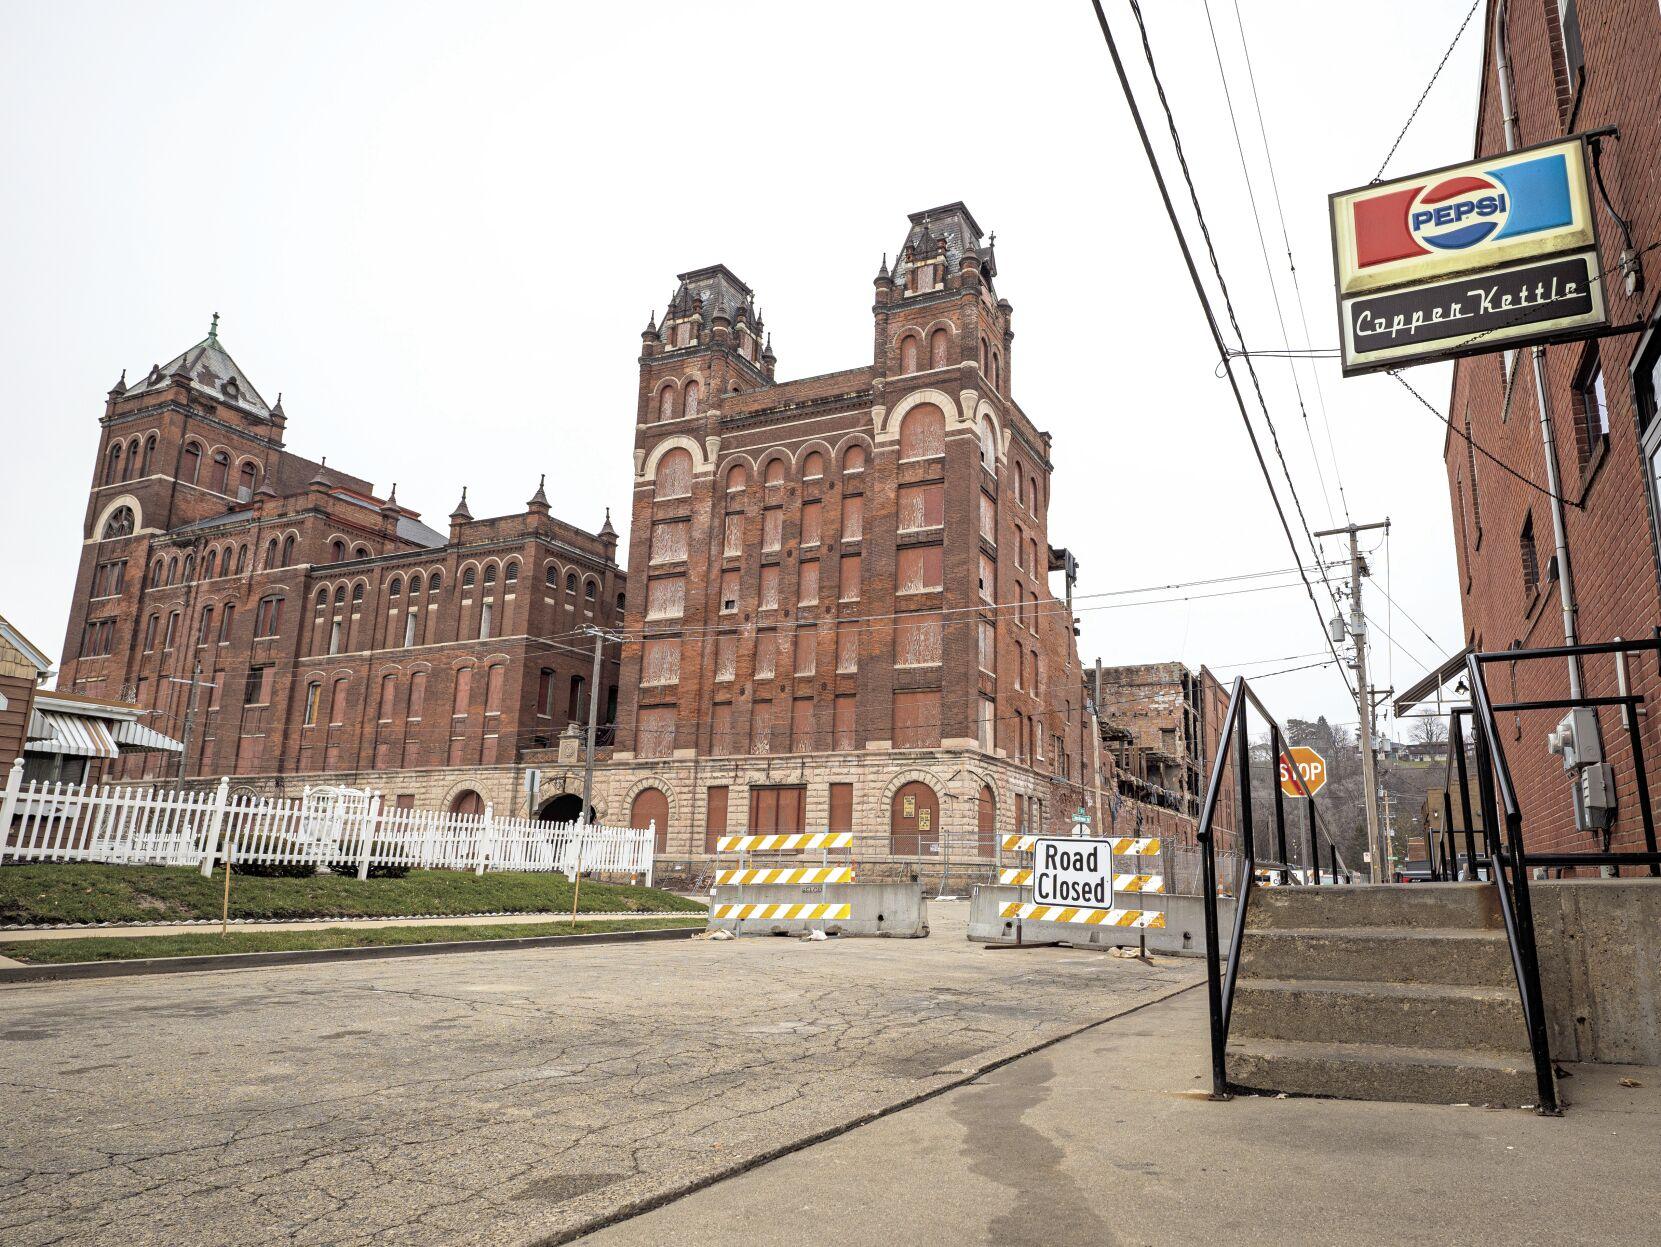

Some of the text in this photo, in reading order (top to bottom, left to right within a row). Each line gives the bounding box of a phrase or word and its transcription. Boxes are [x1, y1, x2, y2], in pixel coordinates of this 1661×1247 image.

[1412, 193, 1507, 232] PEPSI
[1356, 277, 1586, 338] Copper Kettle
[1045, 844, 1098, 872] Road
[1038, 872, 1105, 903] Closed
